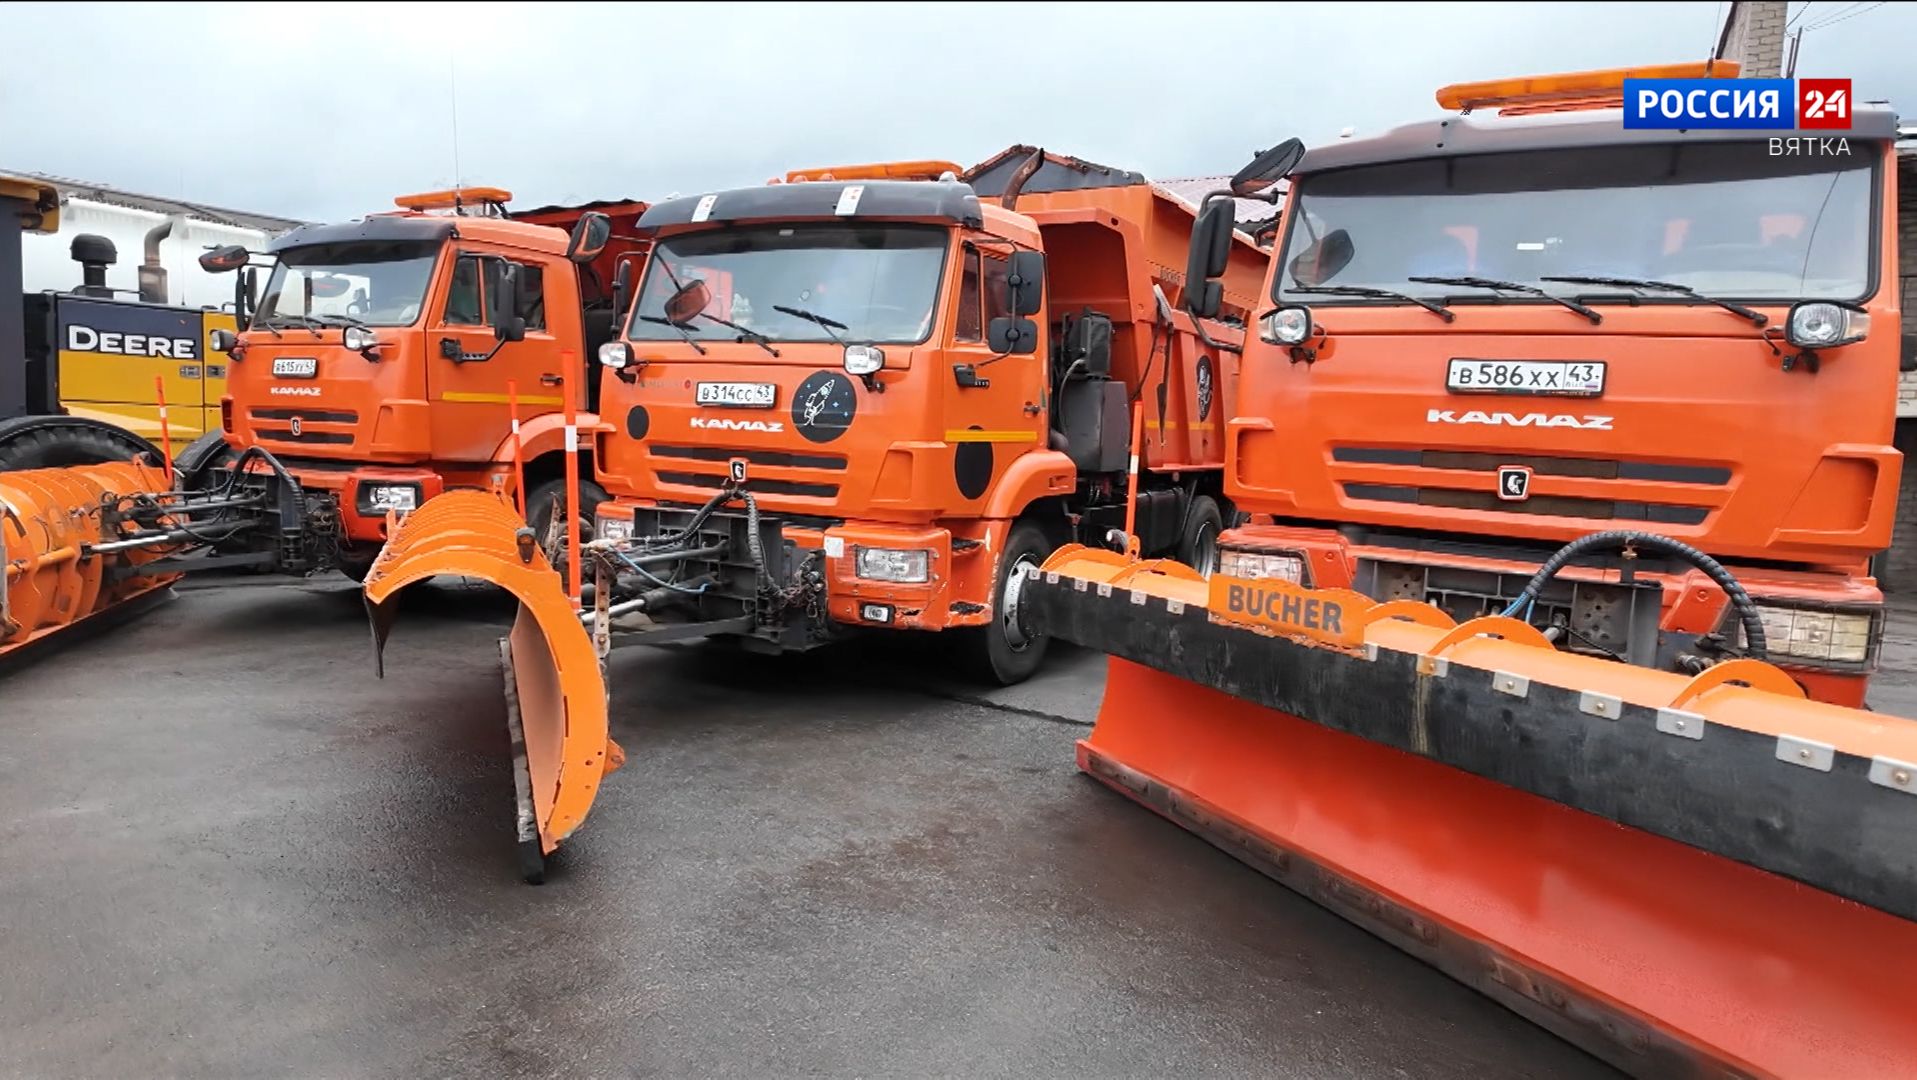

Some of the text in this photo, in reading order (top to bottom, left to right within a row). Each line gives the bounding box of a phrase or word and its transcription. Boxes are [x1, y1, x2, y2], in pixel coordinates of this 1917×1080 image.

[68, 324, 195, 359] DEERE
[1568, 365, 1595, 382] 43
[270, 386, 321, 396] KAMAZ
[689, 416, 784, 432] KAMAZ
[1426, 408, 1615, 430] KAMAZ
[1228, 584, 1342, 633] BUCHER
